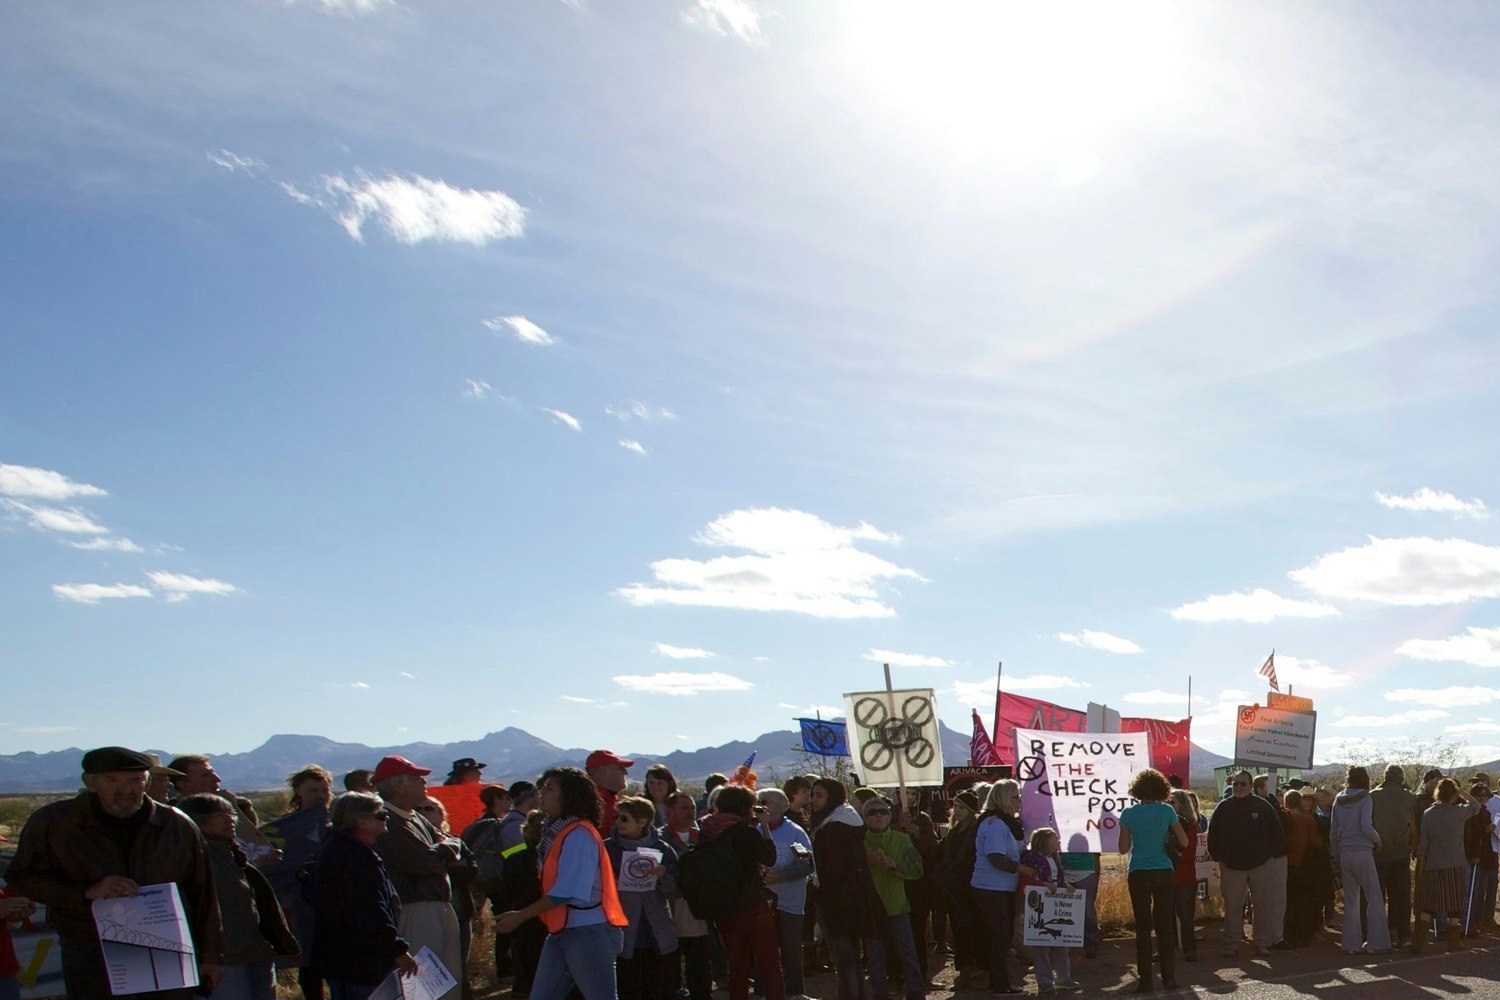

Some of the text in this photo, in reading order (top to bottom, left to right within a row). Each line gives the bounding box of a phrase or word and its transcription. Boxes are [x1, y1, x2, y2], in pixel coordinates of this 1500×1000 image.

[1030, 739, 1136, 758] REMOVE
[950, 768, 988, 776] ARIVACA
[1051, 763, 1095, 778] THE
[1038, 779, 1118, 797] CHECK
